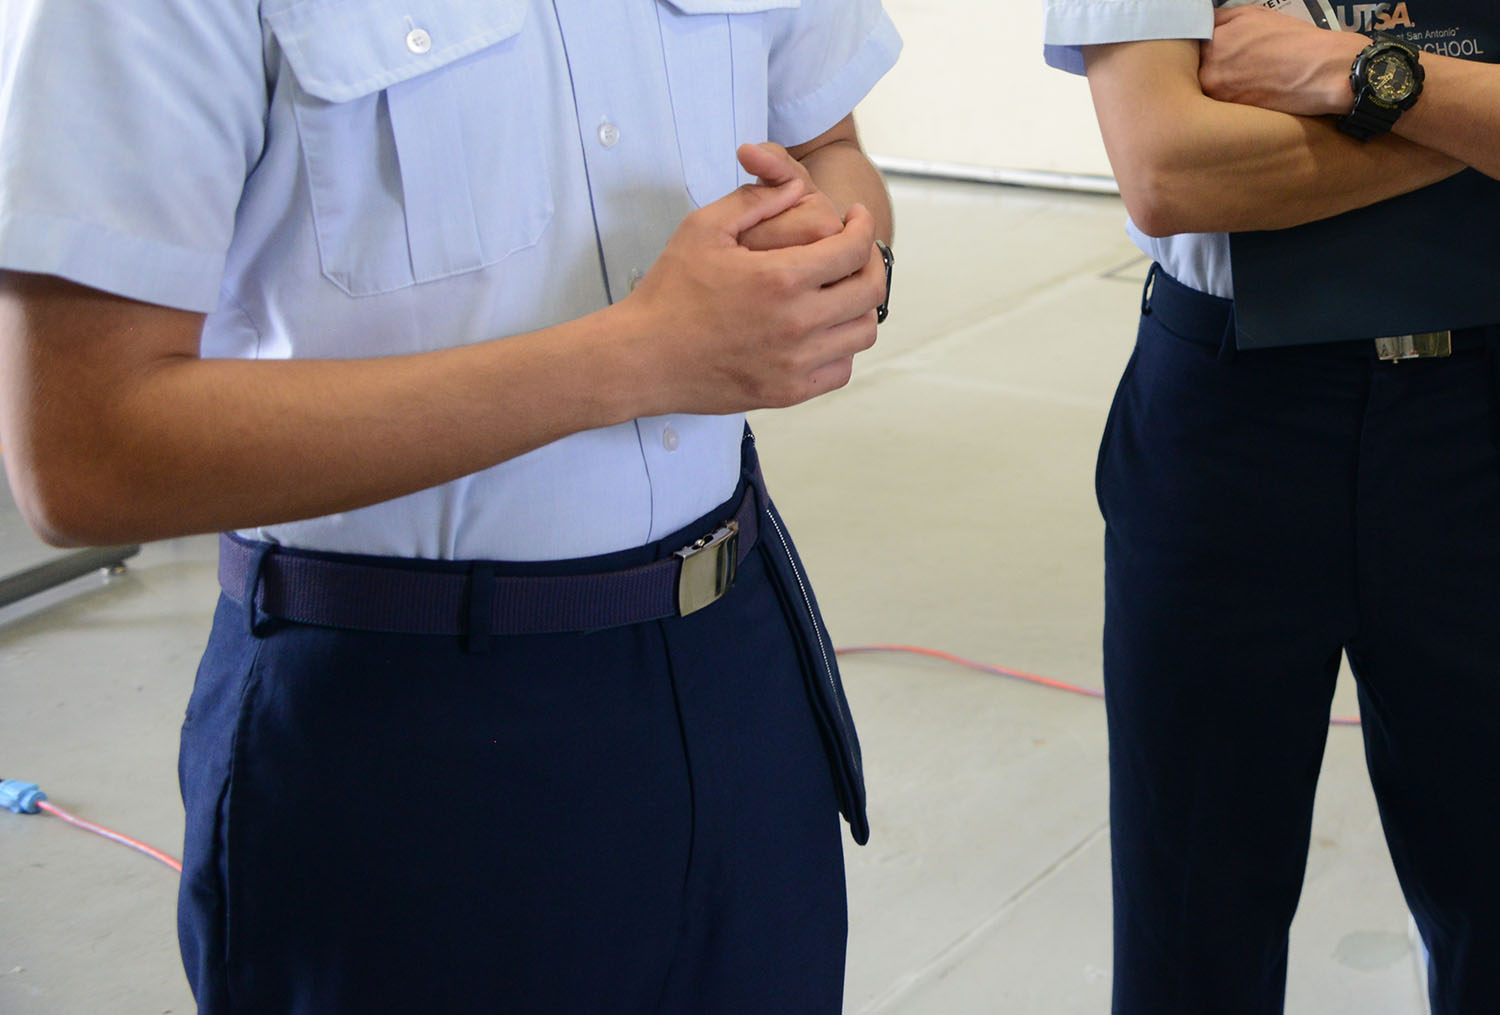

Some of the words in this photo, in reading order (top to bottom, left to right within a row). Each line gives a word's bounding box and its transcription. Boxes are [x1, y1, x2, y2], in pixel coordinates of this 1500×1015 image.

[1406, 31, 1423, 41] San
[1425, 27, 1457, 39] Antonio
[1417, 39, 1485, 57] CHOOL
